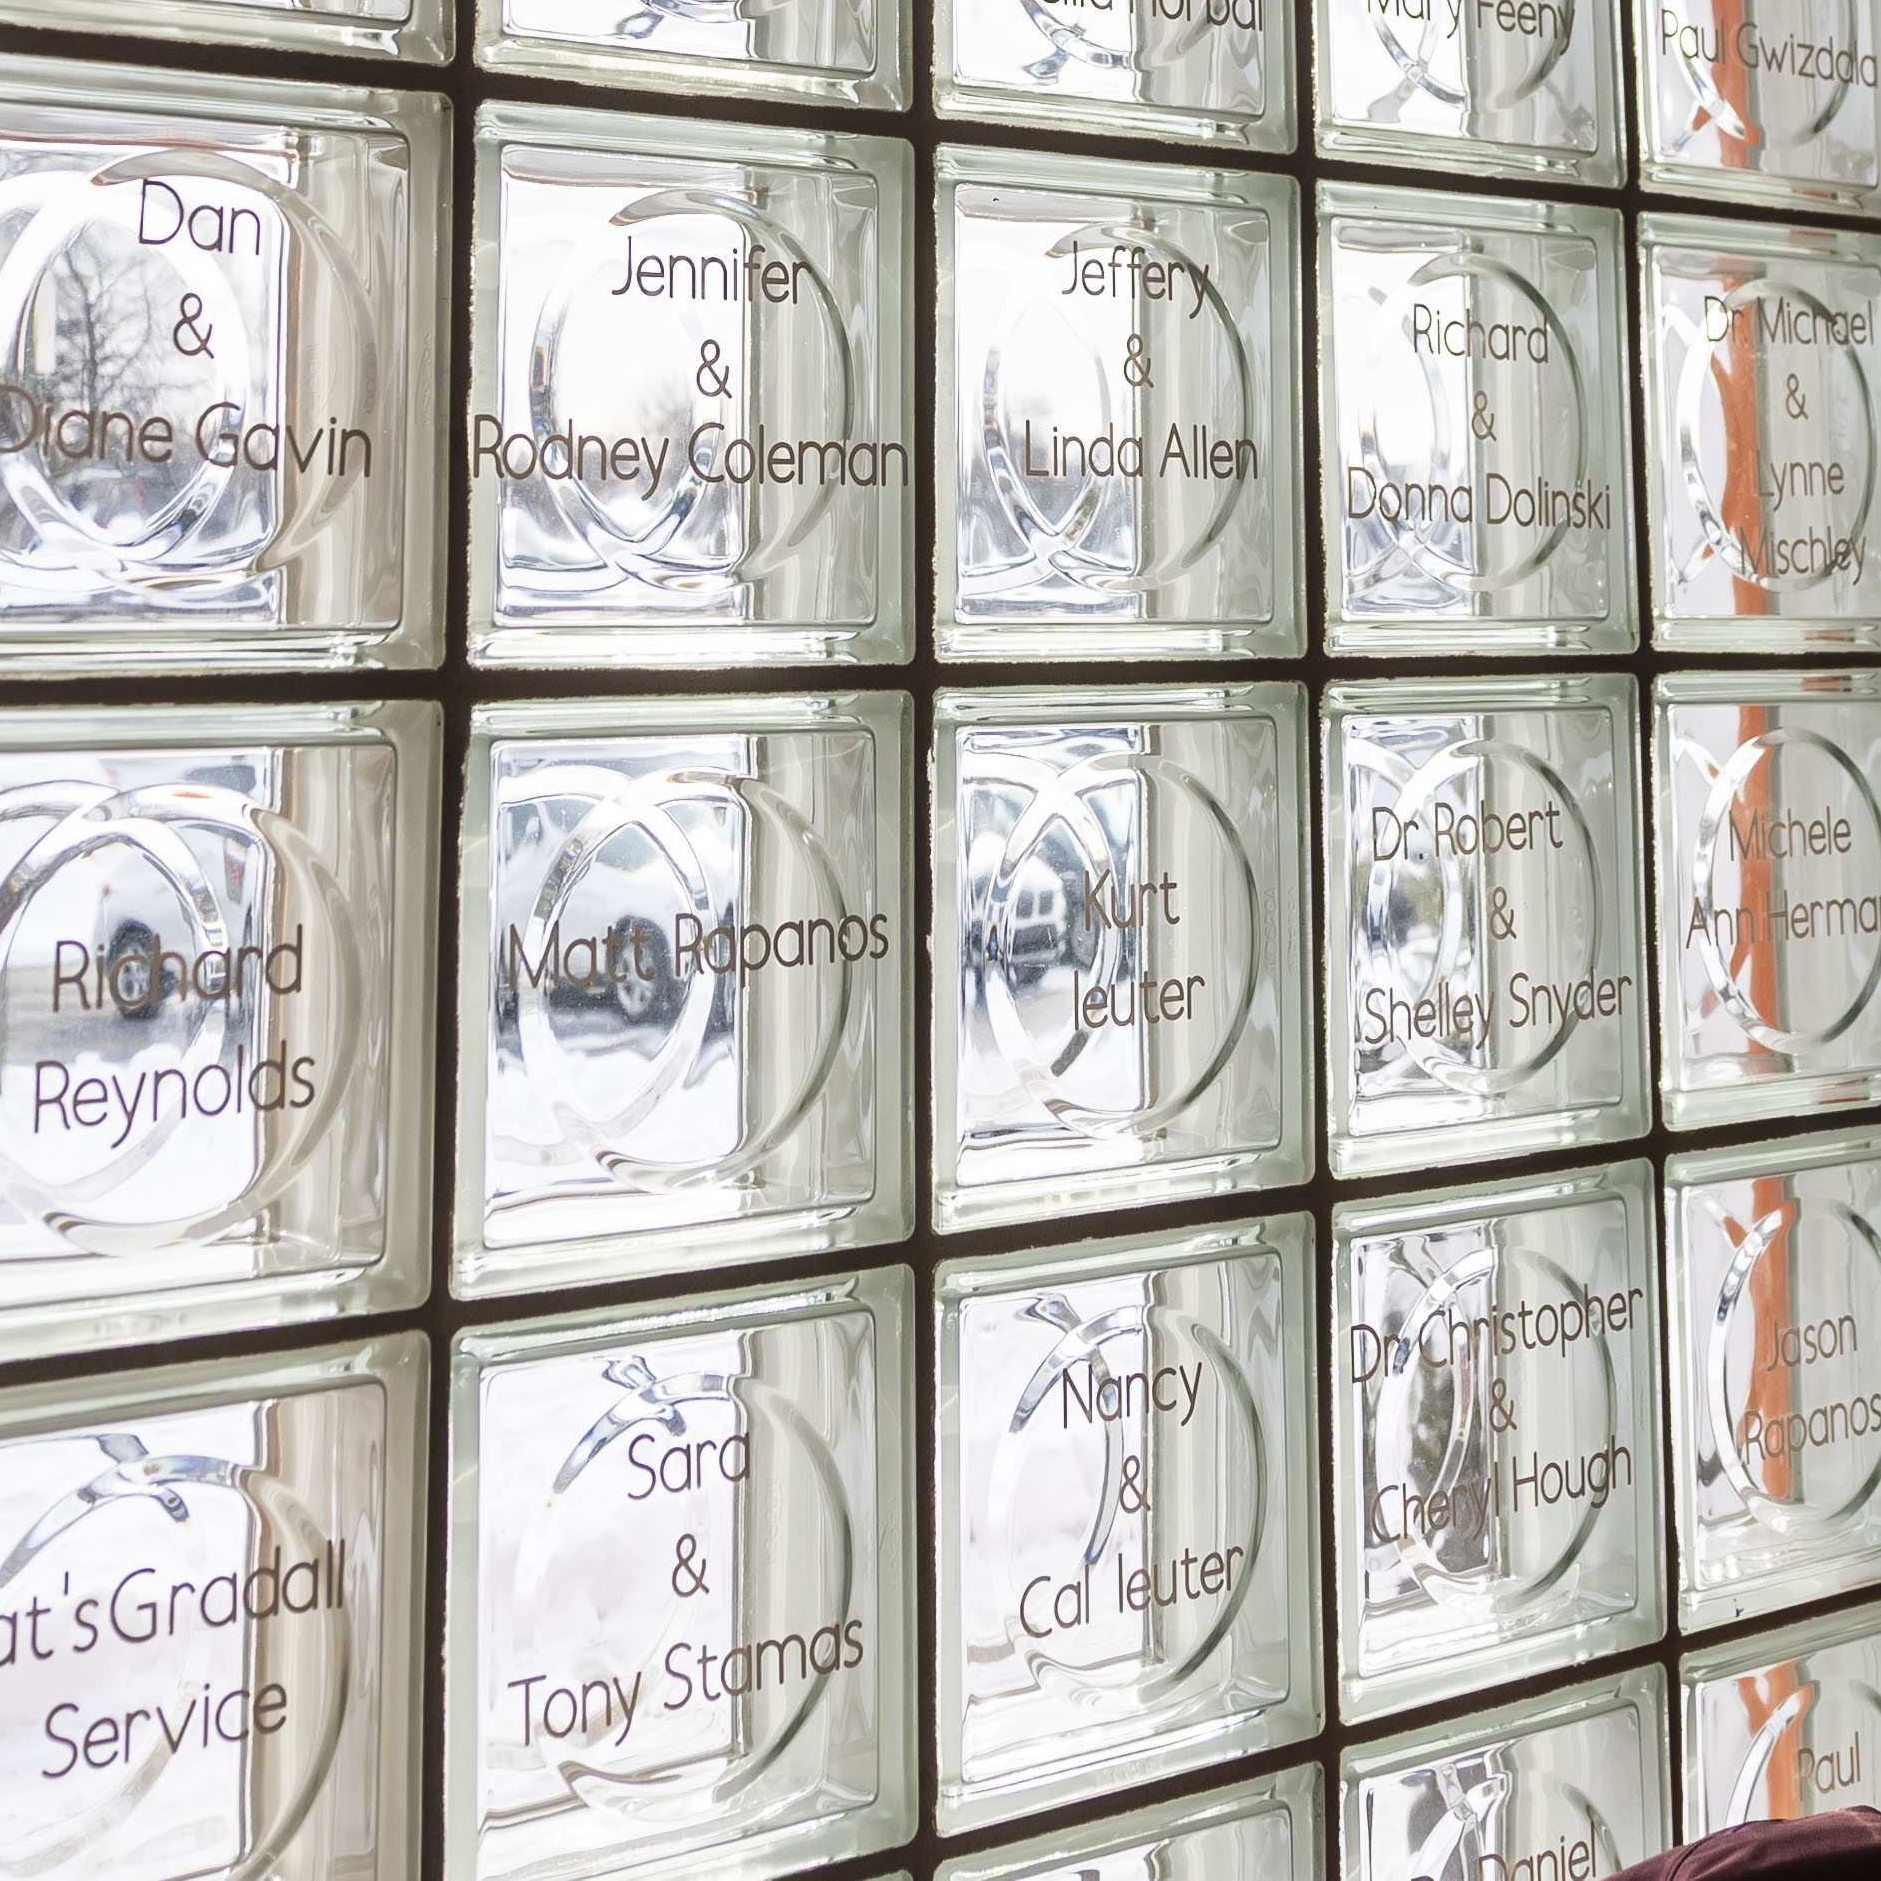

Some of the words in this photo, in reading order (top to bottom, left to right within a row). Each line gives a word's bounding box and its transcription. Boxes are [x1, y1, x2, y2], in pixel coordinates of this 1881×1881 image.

[1661, 10, 1727, 67] Paul
[1735, 20, 1878, 87] Gwizdala
[137, 179, 262, 256] Dan
[611, 236, 813, 306] Jennifer
[1062, 240, 1210, 319] Jeffery
[172, 293, 214, 359] &
[1412, 304, 1549, 365] Richard
[1704, 296, 1748, 345] Dr.
[1759, 297, 1876, 346] Michael
[696, 339, 733, 398] &
[1122, 333, 1154, 388] &
[1471, 391, 1498, 442] &
[1784, 373, 1809, 420] &
[196, 401, 372, 479] Gavin
[474, 414, 668, 500] Rodney
[689, 423, 911, 487] Coleman
[1024, 418, 1144, 480] Linda
[1159, 421, 1259, 480] Allen
[1347, 467, 1473, 524] Donna
[1485, 473, 1611, 530] Dolinski
[1758, 459, 1845, 508] Lynne
[1739, 530, 1866, 586] Mischley
[1371, 806, 1424, 864] Dr.
[1434, 799, 1564, 860] Robert
[1728, 809, 1853, 864] Michele
[1083, 871, 1181, 937] Kurt
[1489, 888, 1517, 940] &
[1686, 887, 1759, 949] Ann
[53, 925, 304, 1013] Richard
[508, 920, 655, 992] Matt
[675, 912, 889, 989] Rapanos
[1364, 975, 1497, 1048] Shelley
[1508, 969, 1633, 1033] Snyder
[34, 1043, 317, 1149] Reynolds
[1419, 1285, 1644, 1366] Christopher
[1766, 1309, 1858, 1366] Jason
[1060, 1358, 1203, 1436] Nancy
[1489, 1379, 1517, 1432] &
[626, 1428, 750, 1500] Sara
[1119, 1453, 1151, 1514] &
[1372, 1474, 1500, 1546] Cheryl
[1514, 1440, 1633, 1512] Hough
[672, 1534, 709, 1595] &
[1019, 1571, 1091, 1641] Cal
[507, 1667, 642, 1746] Tony
[664, 1615, 865, 1712] Stamas
[42, 1684, 289, 1781] Service
[1798, 1731, 1860, 1801] Paul
